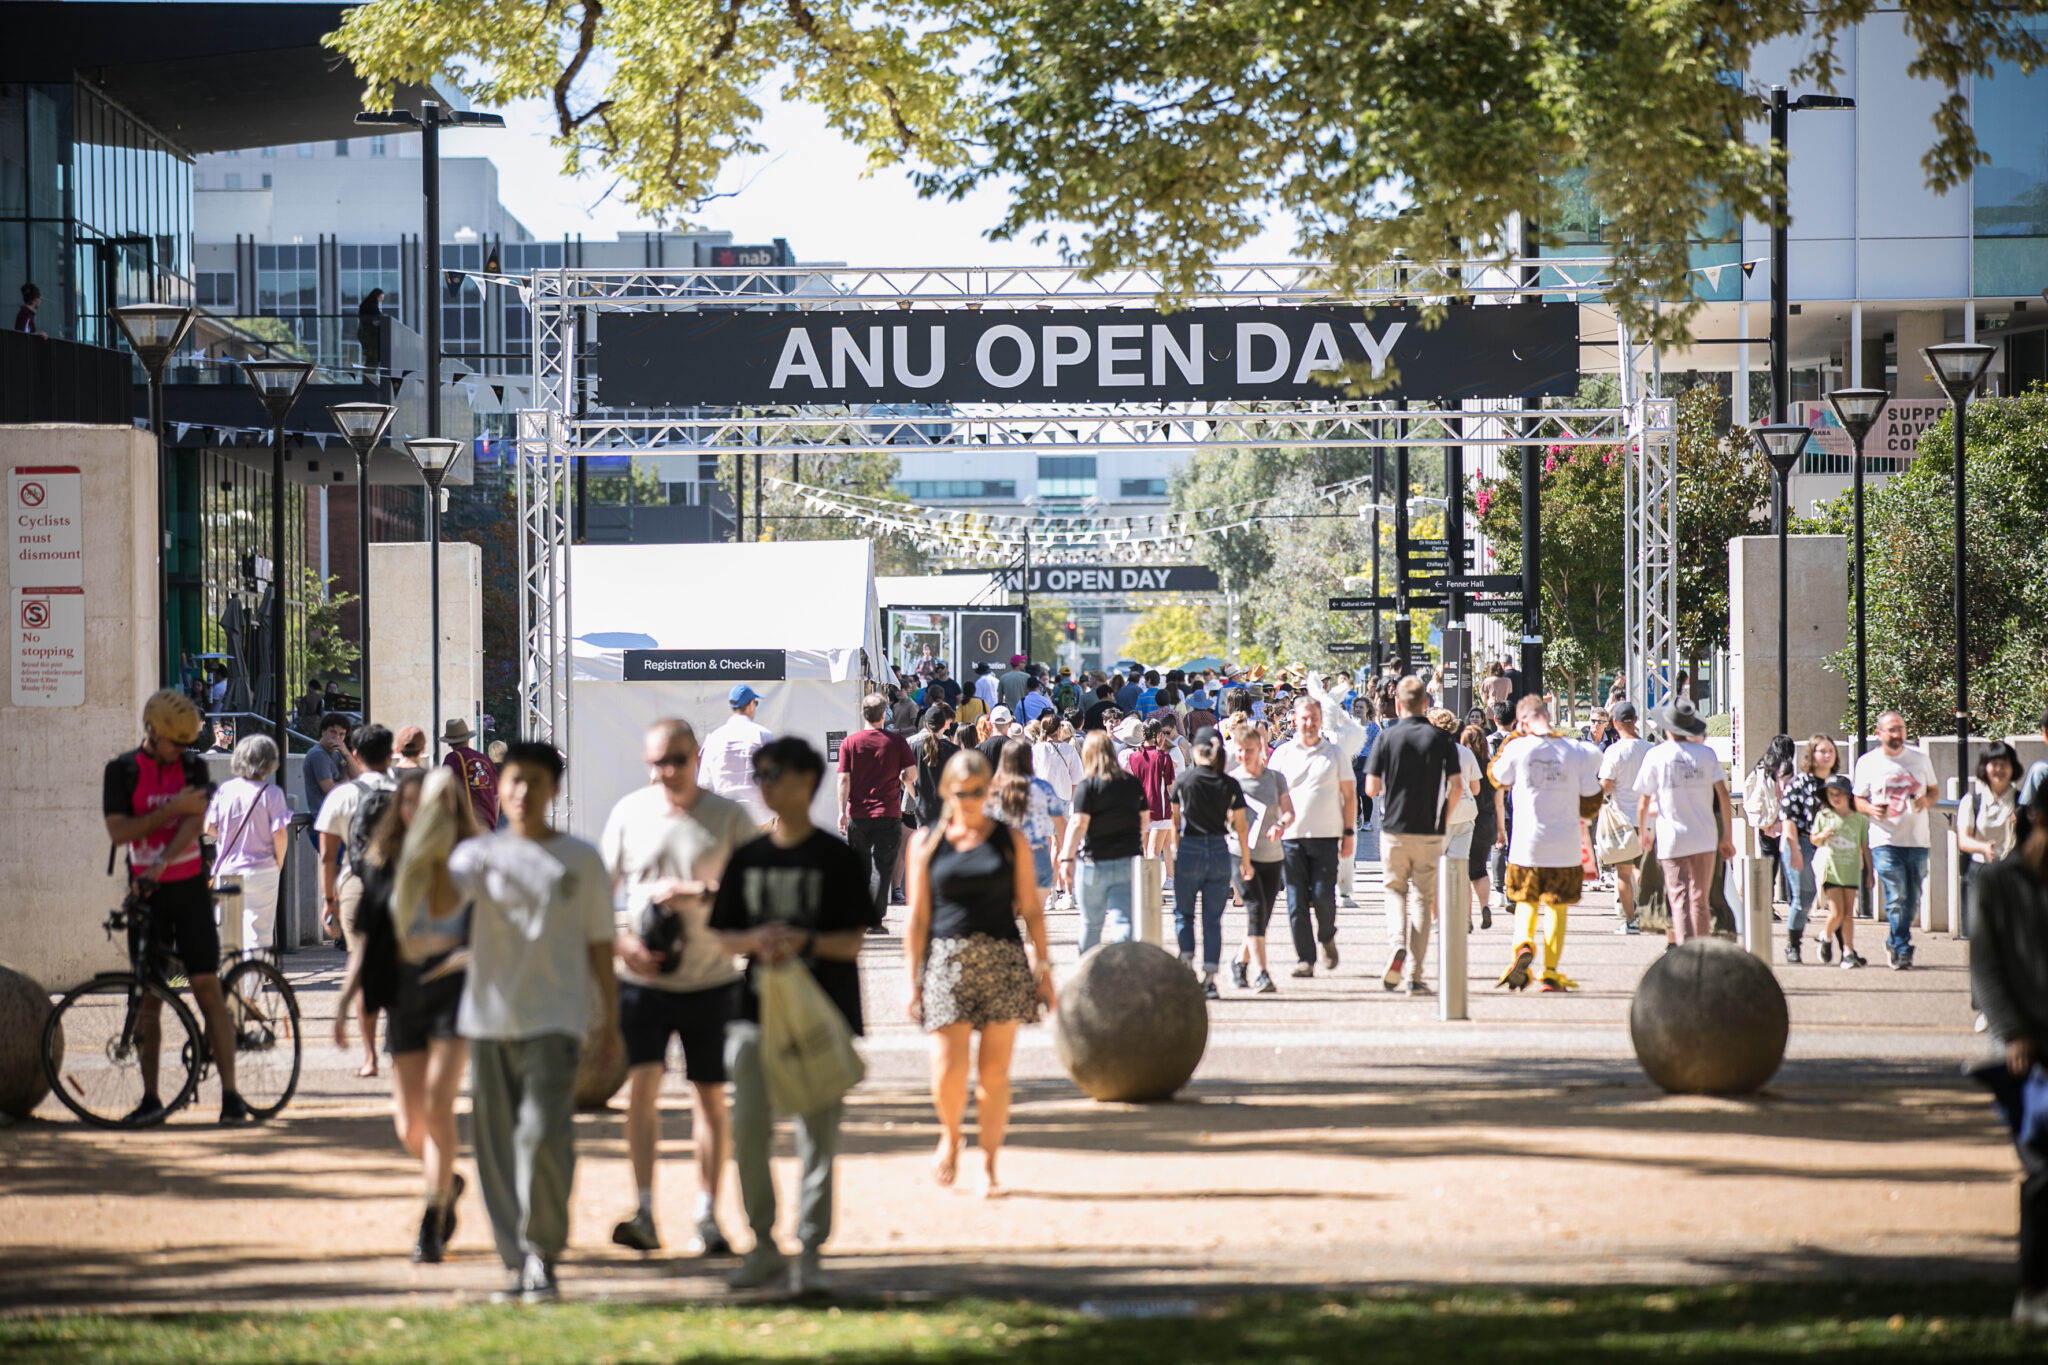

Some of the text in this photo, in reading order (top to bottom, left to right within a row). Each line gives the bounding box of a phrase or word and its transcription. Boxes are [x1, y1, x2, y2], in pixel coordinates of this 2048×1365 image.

[738, 249, 771, 266] nab
[769, 321, 1408, 391] ANU OPEN DAY
[1887, 407, 1947, 421] SUPPO
[18, 515, 71, 530] Cyclists
[19, 533, 51, 544] must
[19, 549, 81, 560] dismount
[1047, 569, 1115, 591] OPEN
[1120, 568, 1170, 590] DAY
[1446, 580, 1485, 588] Fenner Hall
[22, 632, 41, 643] No
[21, 646, 74, 659] stopping
[643, 658, 766, 672] Registration & Check-in
[971, 661, 1007, 670] Inmation
